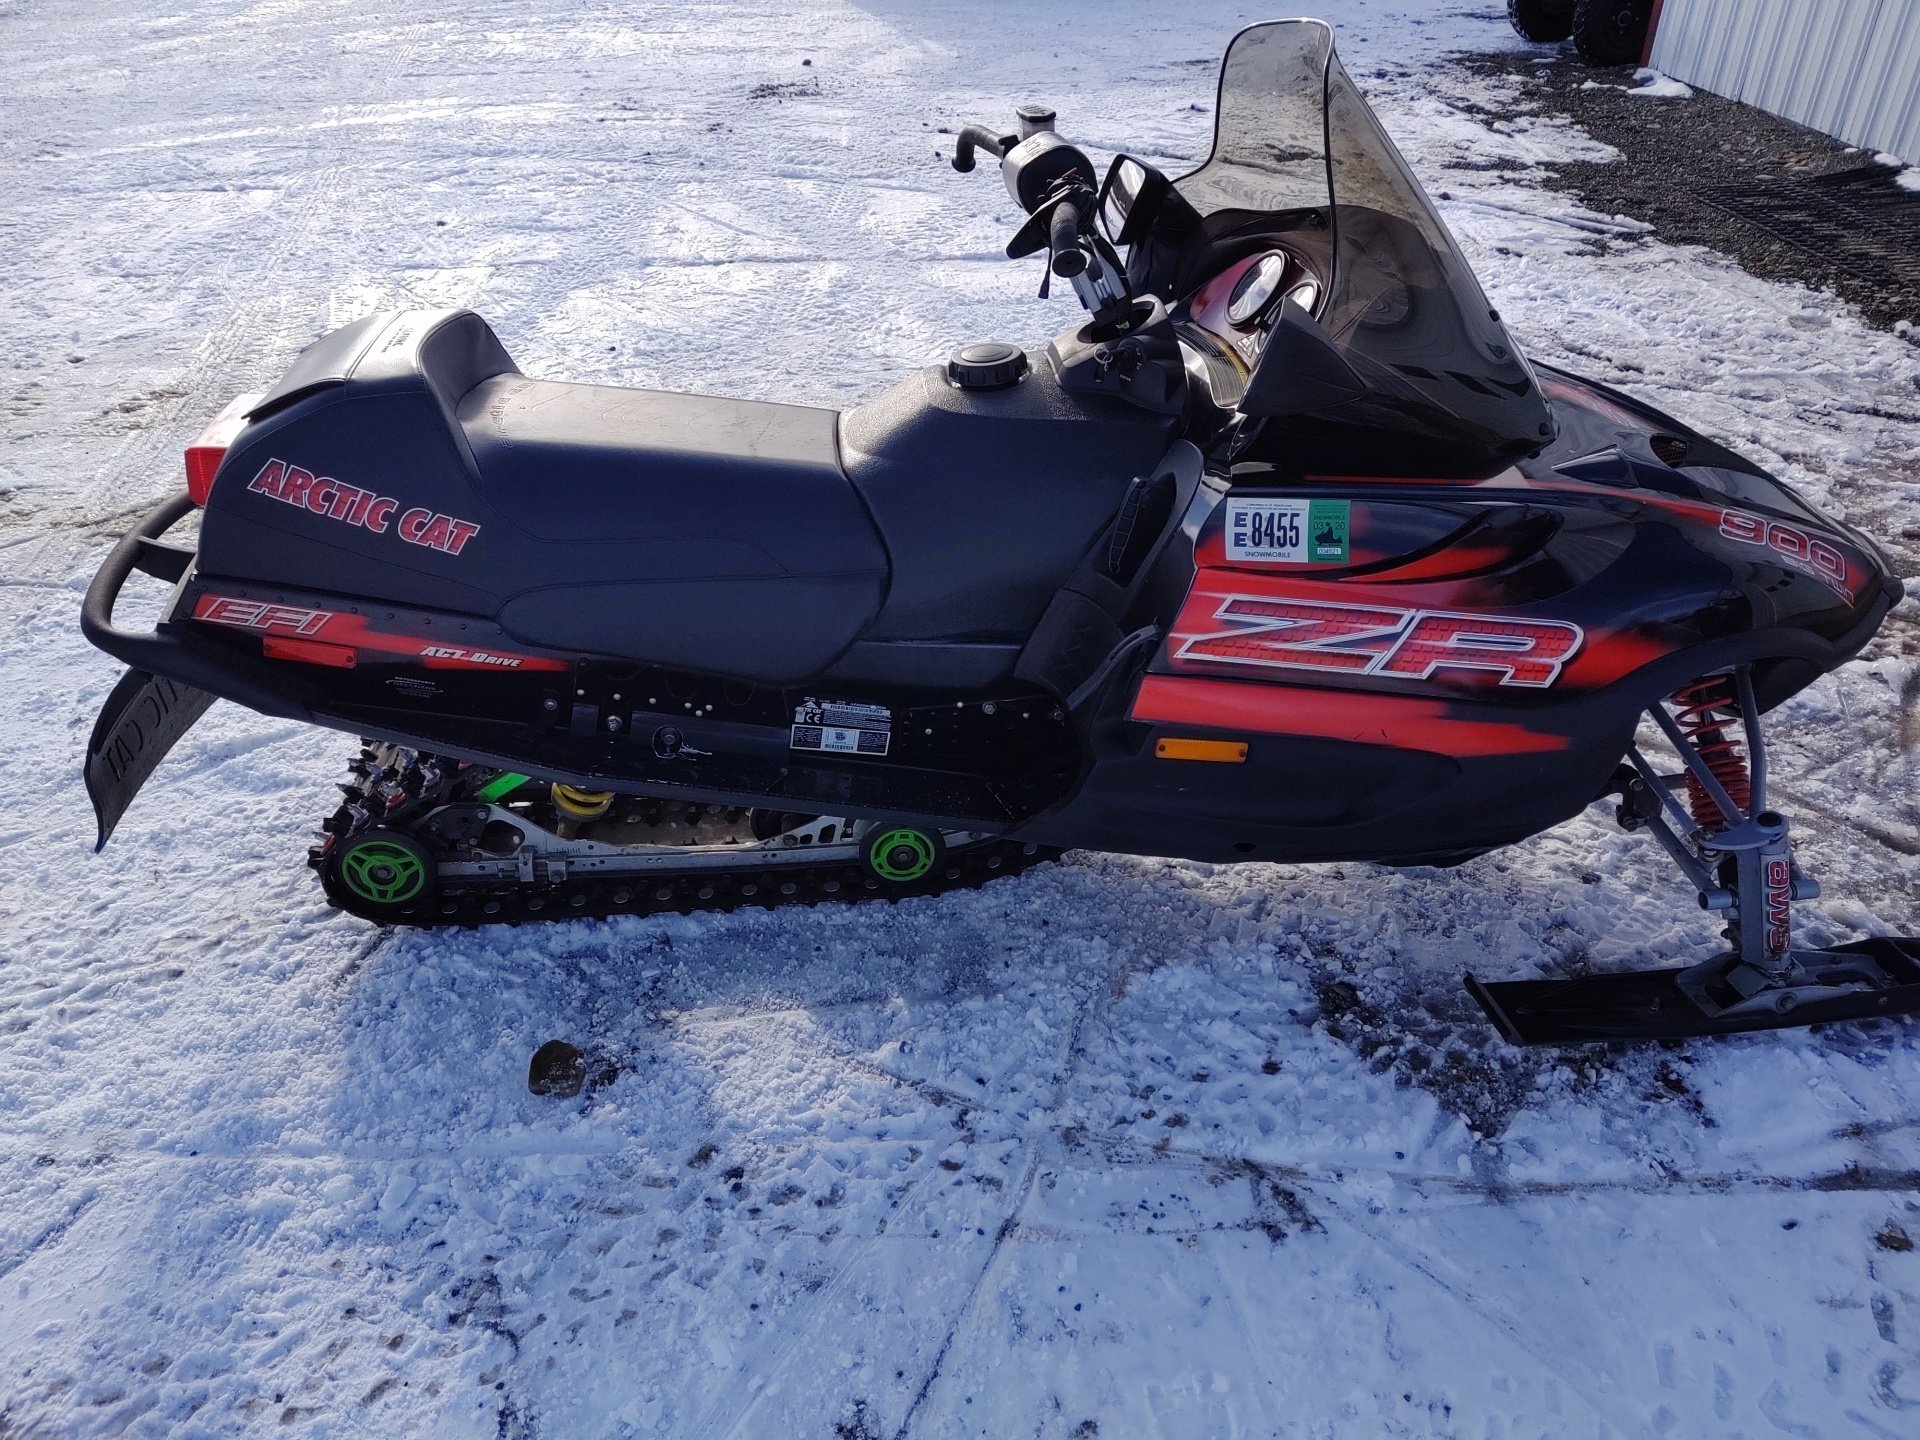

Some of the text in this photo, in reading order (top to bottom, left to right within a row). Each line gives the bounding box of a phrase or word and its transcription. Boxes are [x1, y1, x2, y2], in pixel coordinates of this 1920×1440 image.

[247, 457, 481, 556] ARCTIC CAT
[1251, 511, 1300, 548] 8455
[1335, 521, 1346, 531] 20
[1244, 551, 1291, 559] SNOWMOBILE
[1719, 509, 1845, 581] 900
[201, 598, 333, 635] EFI
[419, 646, 524, 668] ACT DRIVE
[1174, 593, 1584, 688] ZR
